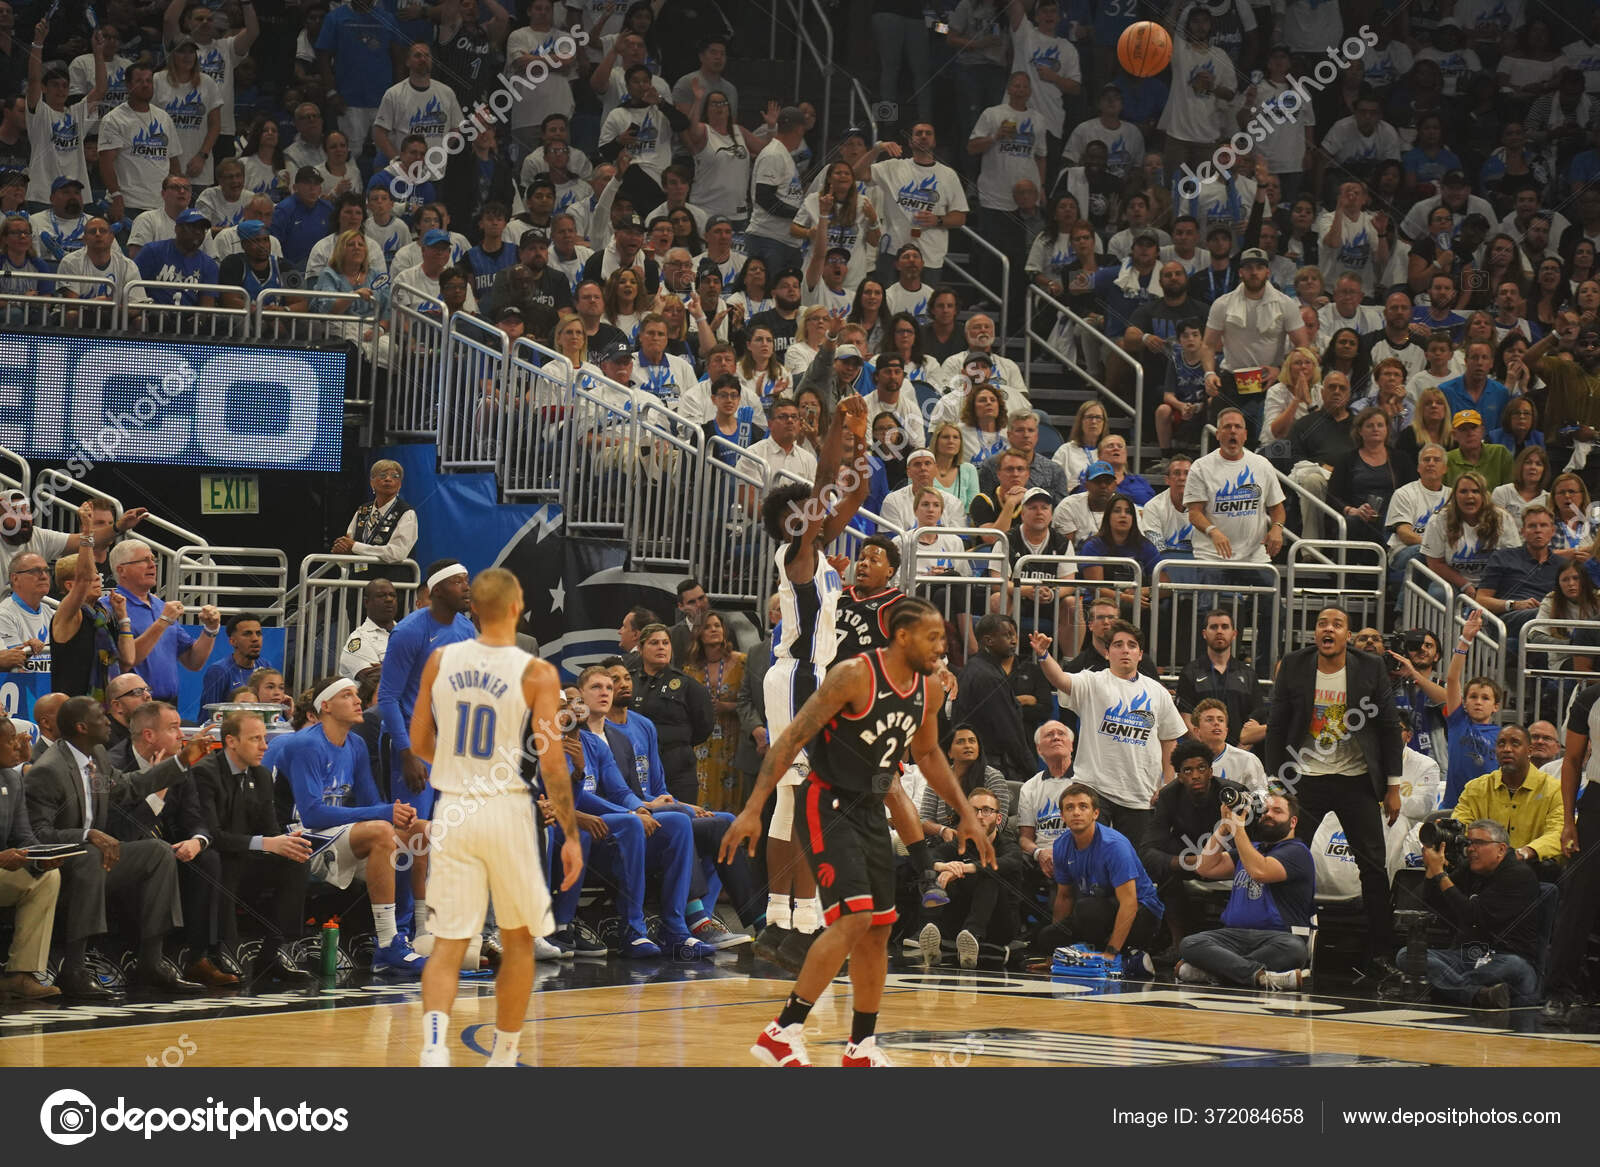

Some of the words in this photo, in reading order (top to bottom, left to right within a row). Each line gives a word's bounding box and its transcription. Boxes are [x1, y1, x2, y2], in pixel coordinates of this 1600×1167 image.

[133, 144, 168, 157] IGNITE
[896, 197, 935, 212] IGNITE
[211, 478, 252, 510] EXIT
[1215, 500, 1259, 512] IGNITE
[835, 609, 872, 646] PTORS
[449, 670, 509, 699] FOURNIER
[453, 701, 497, 761] 10
[1101, 721, 1151, 741] IGNITE
[1112, 735, 1147, 747] PLAYOFFS
[879, 738, 898, 768] 2
